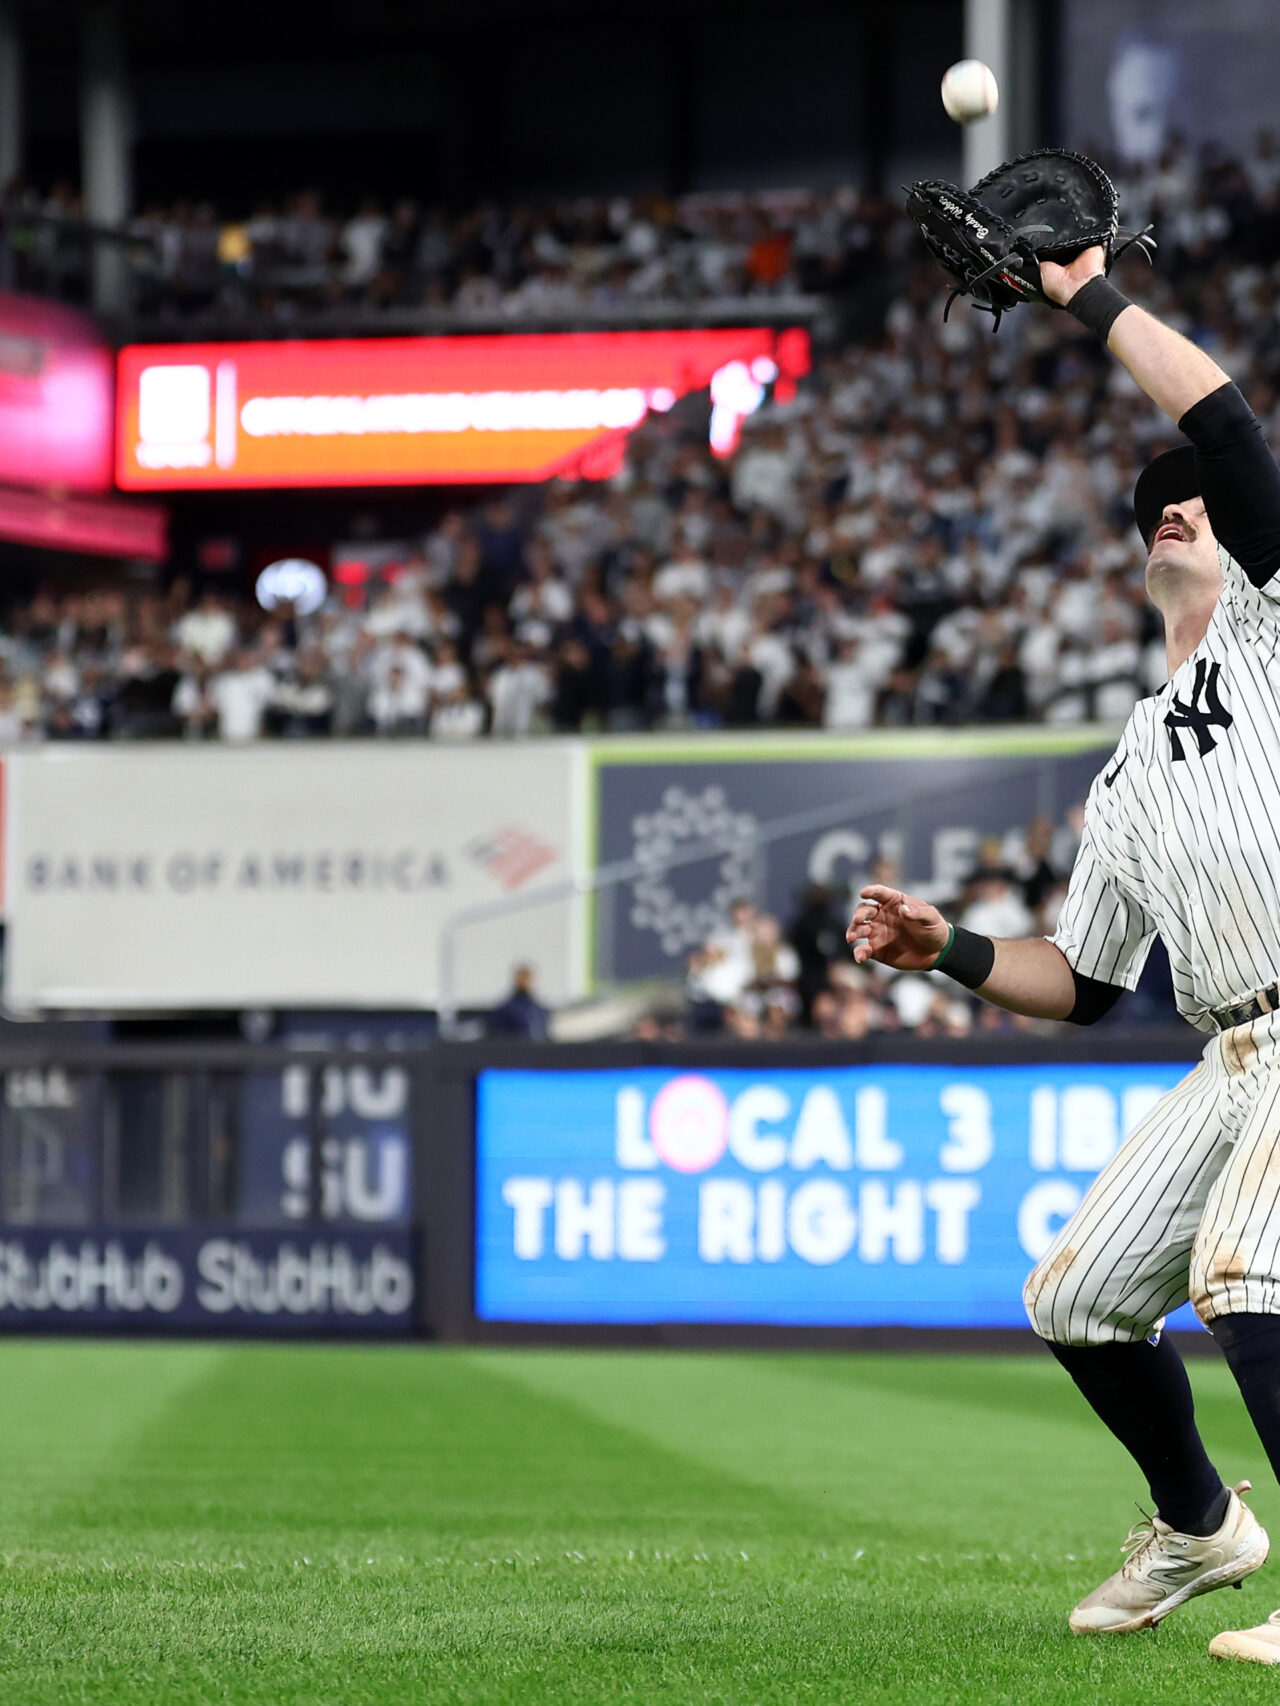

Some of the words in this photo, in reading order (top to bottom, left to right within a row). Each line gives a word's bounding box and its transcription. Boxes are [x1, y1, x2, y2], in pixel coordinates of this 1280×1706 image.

[1163, 657, 1233, 762] NY
[26, 851, 152, 894] BANK
[165, 851, 224, 894] OF
[238, 850, 452, 893] AMERICA
[615, 1076, 901, 1172] LOCAL
[938, 1084, 993, 1173] 3
[505, 1179, 666, 1261] THE
[699, 1179, 981, 1265] RIGHT
[197, 1237, 414, 1315] StubHub
